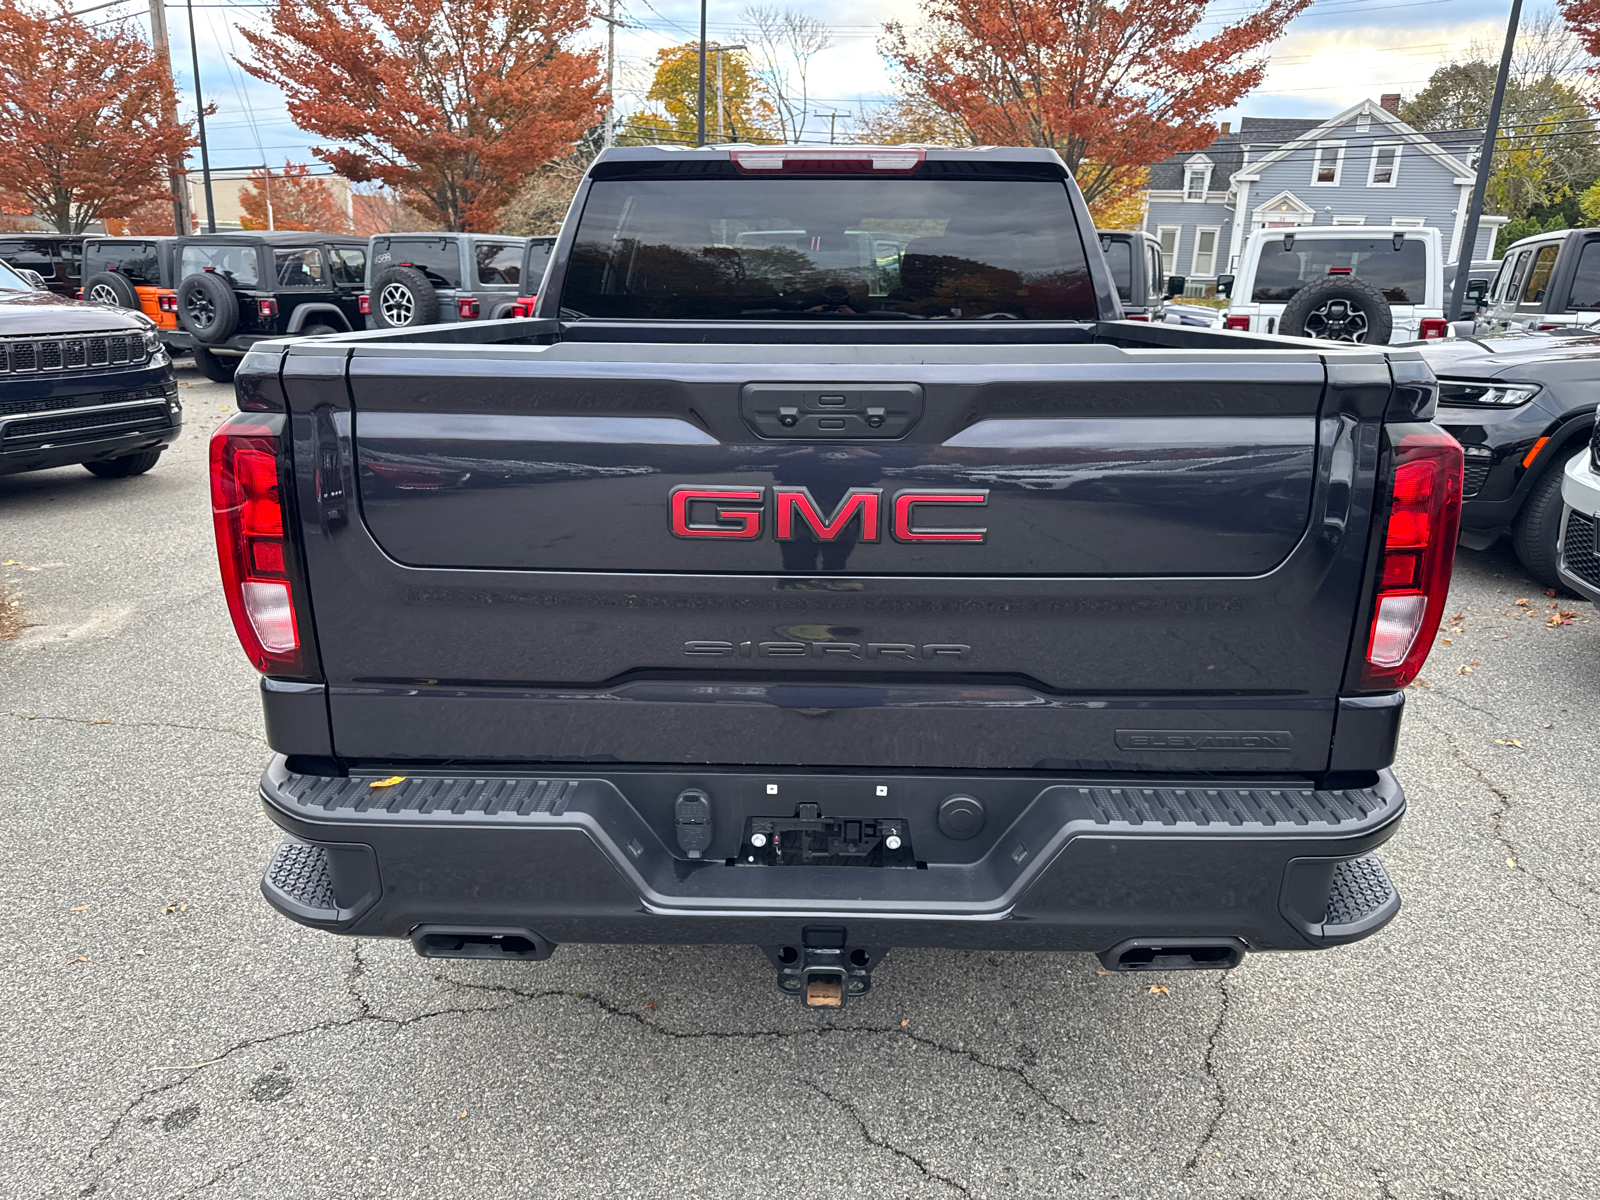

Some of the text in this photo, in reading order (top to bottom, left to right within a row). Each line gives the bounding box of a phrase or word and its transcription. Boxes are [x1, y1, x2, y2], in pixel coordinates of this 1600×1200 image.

[668, 484, 990, 544] GMC
[684, 640, 972, 660] SIERRA
[1130, 735, 1283, 748] ELEVATION
